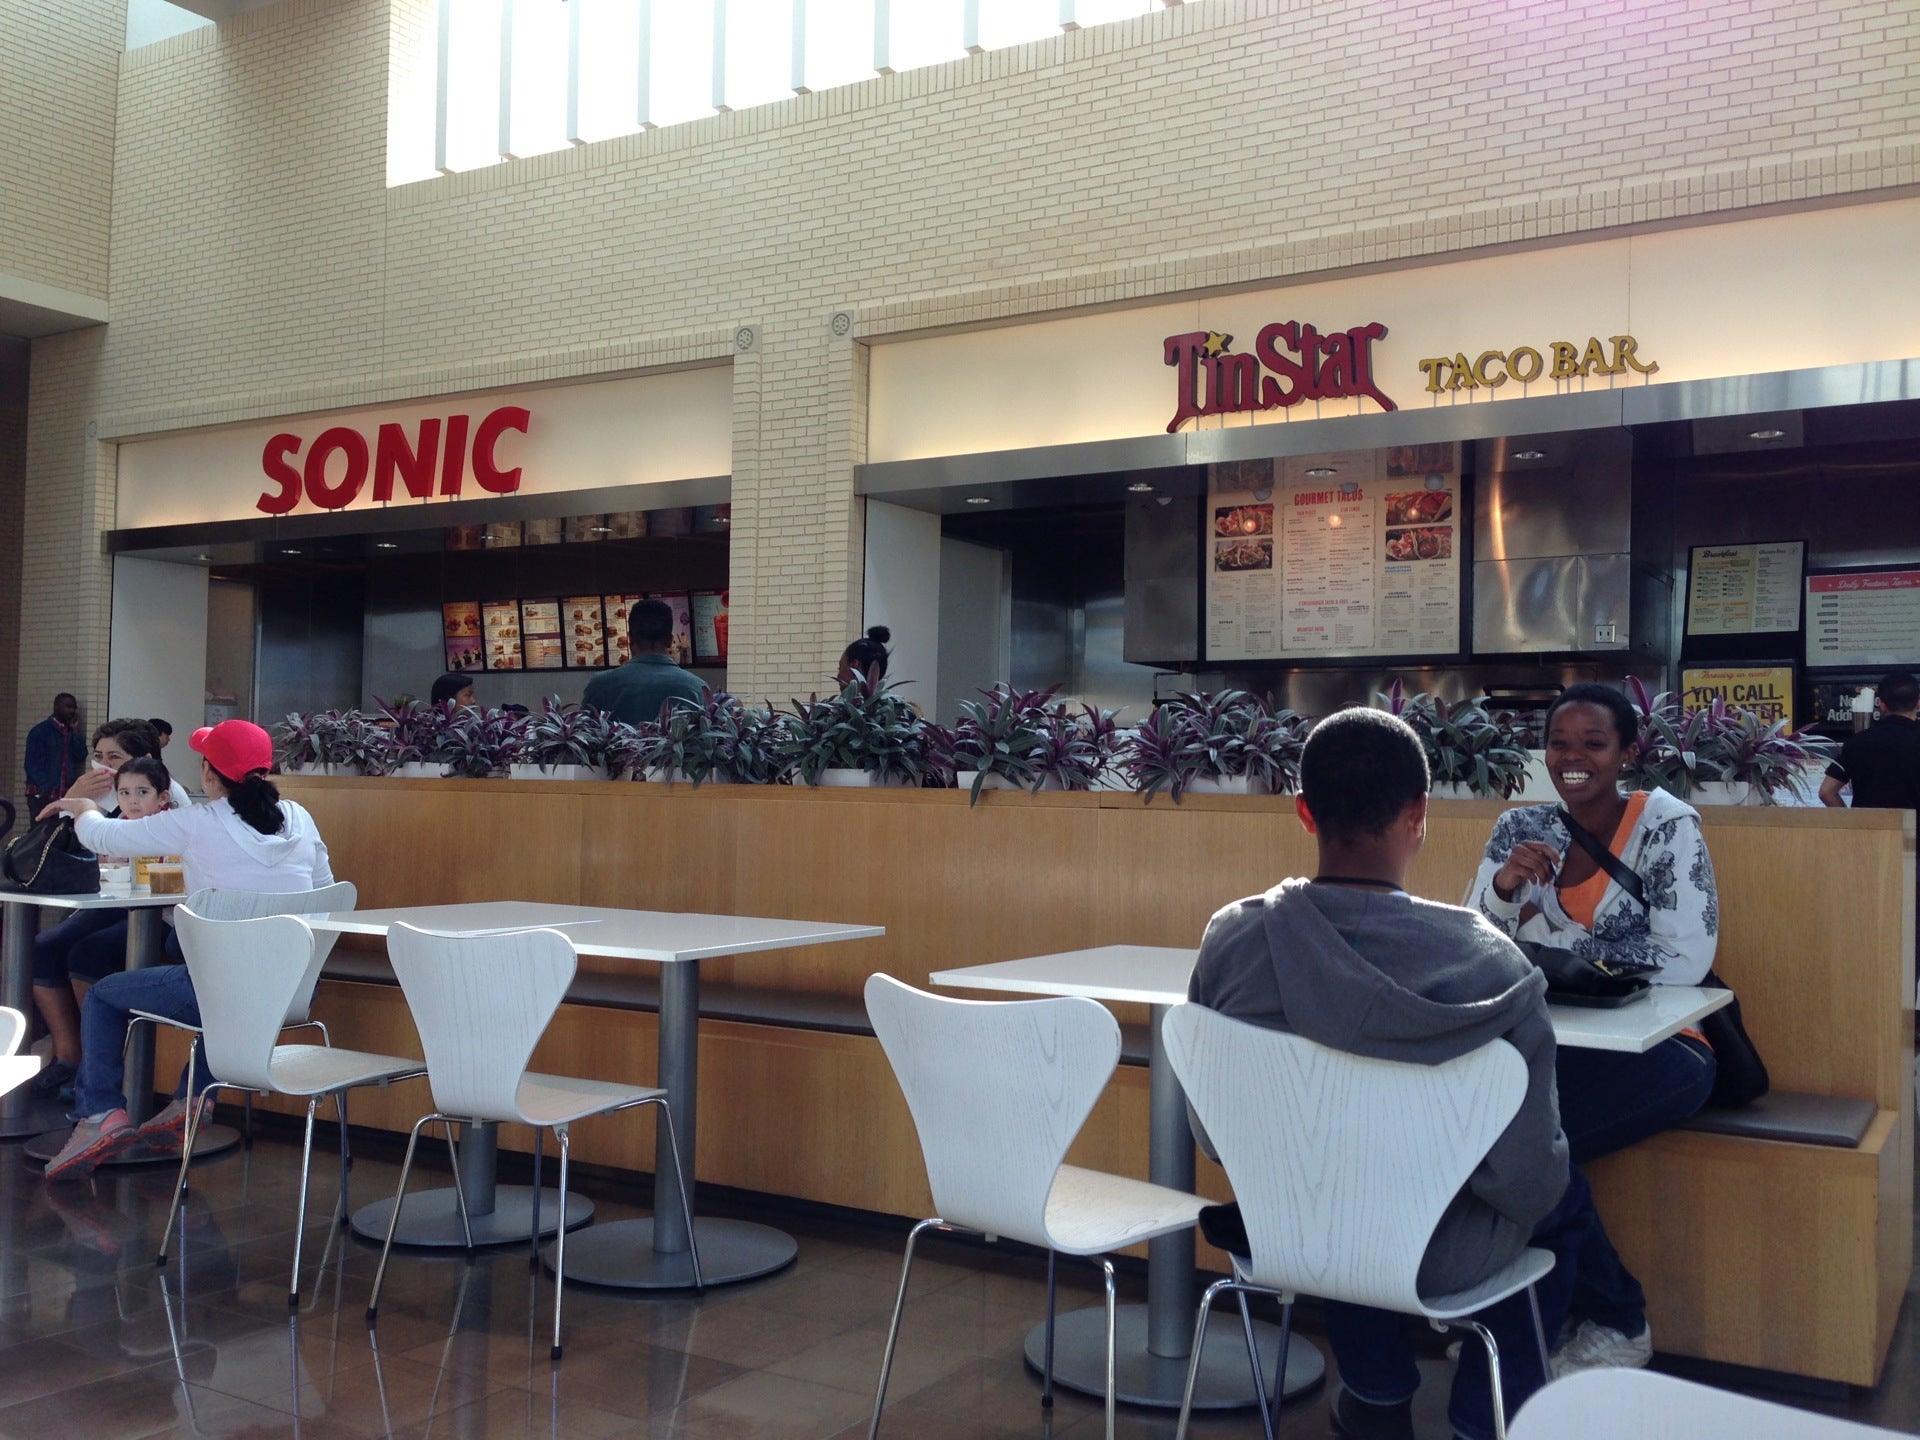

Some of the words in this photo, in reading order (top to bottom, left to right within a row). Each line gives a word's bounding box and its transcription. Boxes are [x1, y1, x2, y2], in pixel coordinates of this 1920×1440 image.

[1418, 345, 1543, 394] TACO
[1549, 335, 1659, 380] BAR
[256, 406, 531, 514] SONIC
[1294, 491, 1334, 506] GOURMET
[1337, 488, 1364, 503] TACOS
[1702, 549, 1739, 559] Breakfast
[1838, 580, 1859, 589] Daily
[1691, 685, 1727, 704] YOU
[1733, 683, 1784, 701] CALL.
